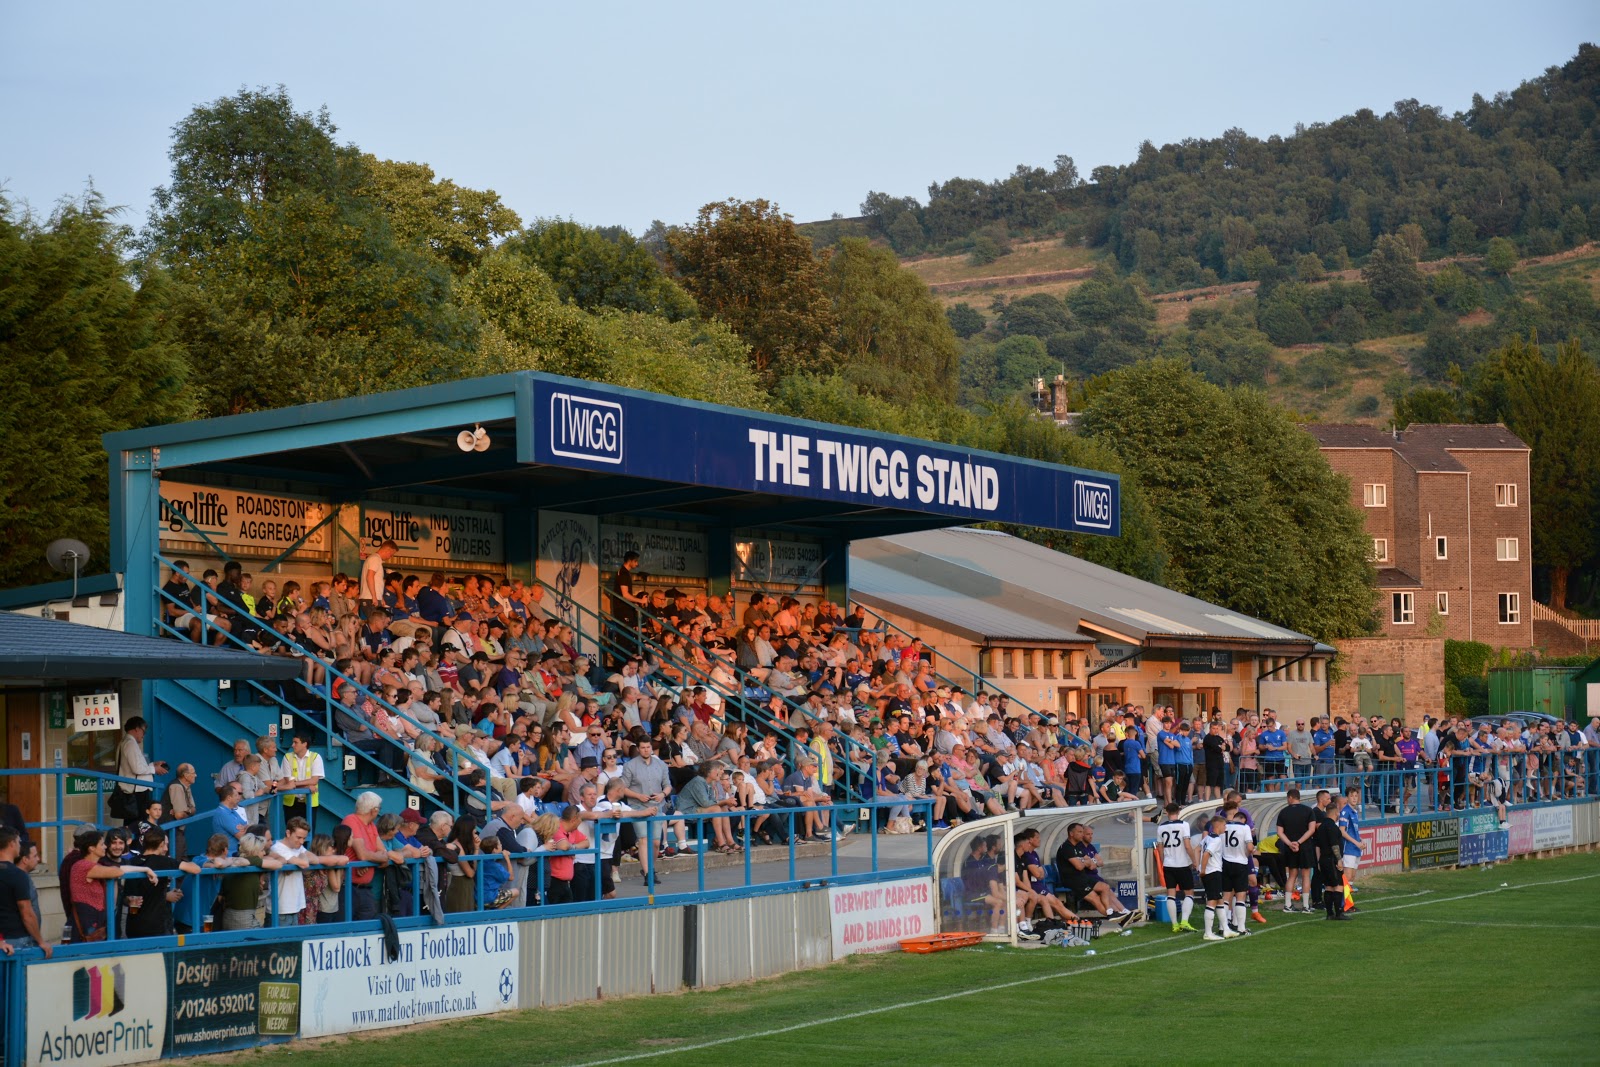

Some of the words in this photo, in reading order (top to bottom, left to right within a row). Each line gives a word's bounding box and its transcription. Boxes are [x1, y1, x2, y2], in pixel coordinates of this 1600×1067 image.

[557, 393, 617, 452] TWIGG
[748, 428, 810, 487] THE
[816, 439, 909, 500] TWIGG
[916, 454, 999, 511] STAND
[236, 495, 314, 520] ROADSTONE
[1077, 480, 1109, 521] TWIGG
[159, 491, 228, 532] ngcliffe
[239, 520, 323, 545] AGGREGATES
[365, 510, 420, 548] ngcliffe
[429, 513, 497, 535] INDUSTRIAL
[435, 536, 491, 556] POWDERS
[541, 519, 569, 554] MATLOCK
[569, 519, 588, 541] TOWN
[644, 534, 703, 553] AGRICULTURAL
[662, 555, 686, 572] LIMES
[83, 696, 110, 705] TEA
[84, 706, 111, 716] BAR
[81, 717, 115, 727] OPEN
[284, 718, 290, 726] D
[347, 758, 353, 766] C
[74, 778, 99, 792] Medica
[411, 799, 417, 807] B
[1161, 830, 1181, 848] 23
[1224, 830, 1239, 848] 16
[1376, 826, 1402, 844] ADHESIVES
[1415, 821, 1431, 839] A&R
[1431, 819, 1458, 837] SLATER
[834, 888, 883, 914] DERWENT
[885, 883, 928, 908] CARPETS
[1119, 889, 1137, 897] TEAM
[843, 922, 865, 945] AND
[866, 916, 901, 941] BLINDS
[903, 914, 922, 936] LTD
[307, 938, 372, 972] Matlock
[378, 936, 413, 965] Twn
[420, 927, 477, 960] Football
[483, 925, 514, 953] Club
[175, 957, 219, 988] Design
[229, 953, 259, 979] Print
[268, 952, 298, 979] Copy
[367, 975, 392, 996] Visit
[396, 972, 415, 992] Our
[420, 969, 441, 988] Web
[444, 966, 462, 986] site
[266, 986, 279, 999] FOR
[279, 986, 290, 999] ALL
[186, 996, 218, 1018] 01246
[220, 993, 255, 1014] 592012
[261, 1001, 277, 1014] YOUR
[277, 1002, 297, 1015] PRINT
[352, 991, 478, 1025] www.matlocktownfc.co.uk
[174, 1022, 257, 1044] www.ashoverprint.co.uk
[266, 1017, 289, 1031] NEEDS!
[39, 1018, 153, 1063] AshoverPrint
